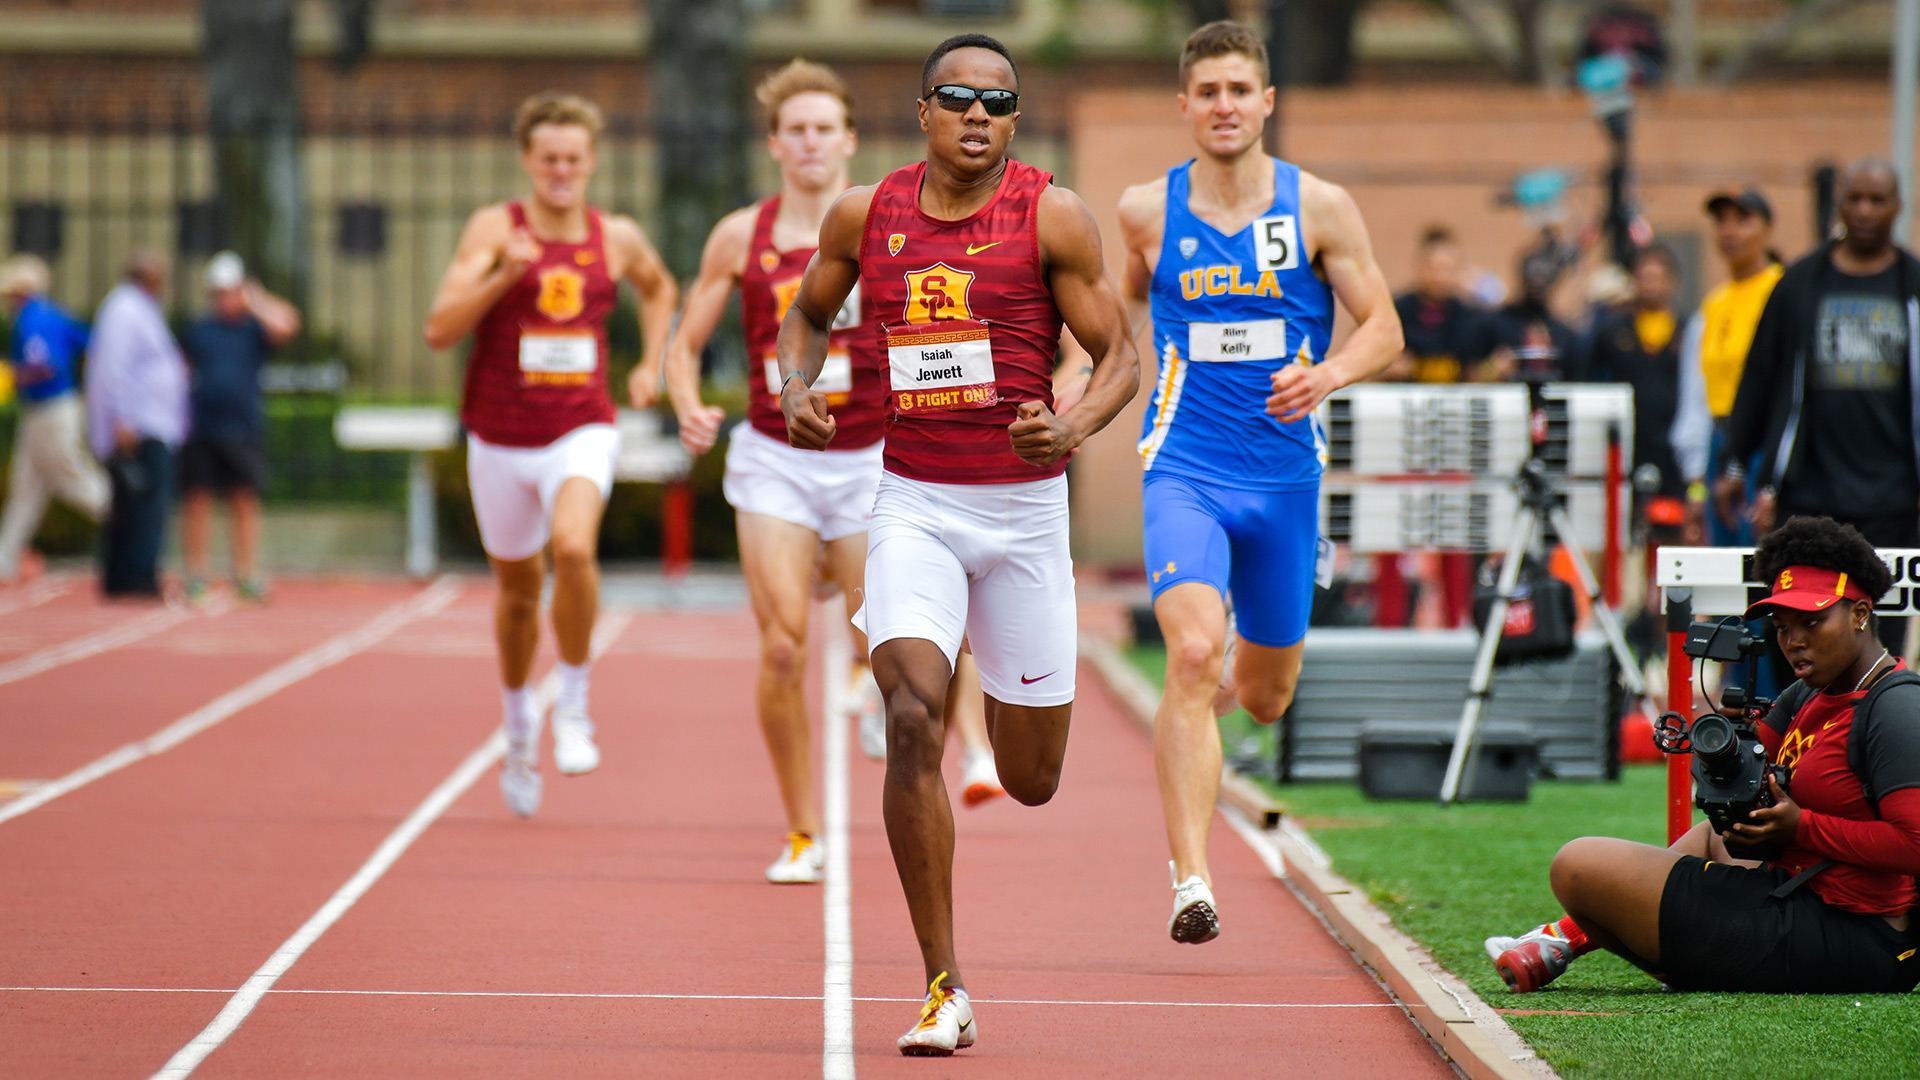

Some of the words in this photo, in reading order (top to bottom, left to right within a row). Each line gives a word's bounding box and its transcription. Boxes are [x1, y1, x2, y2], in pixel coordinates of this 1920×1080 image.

[1266, 221, 1288, 267] 5
[1179, 265, 1284, 301] UCLA
[1223, 328, 1248, 338] Riley
[921, 349, 953, 361] Isaiah
[1221, 342, 1252, 356] Kelly
[916, 365, 963, 382] Jewett
[916, 391, 960, 408] FIGHT
[963, 388, 990, 404] ON!
